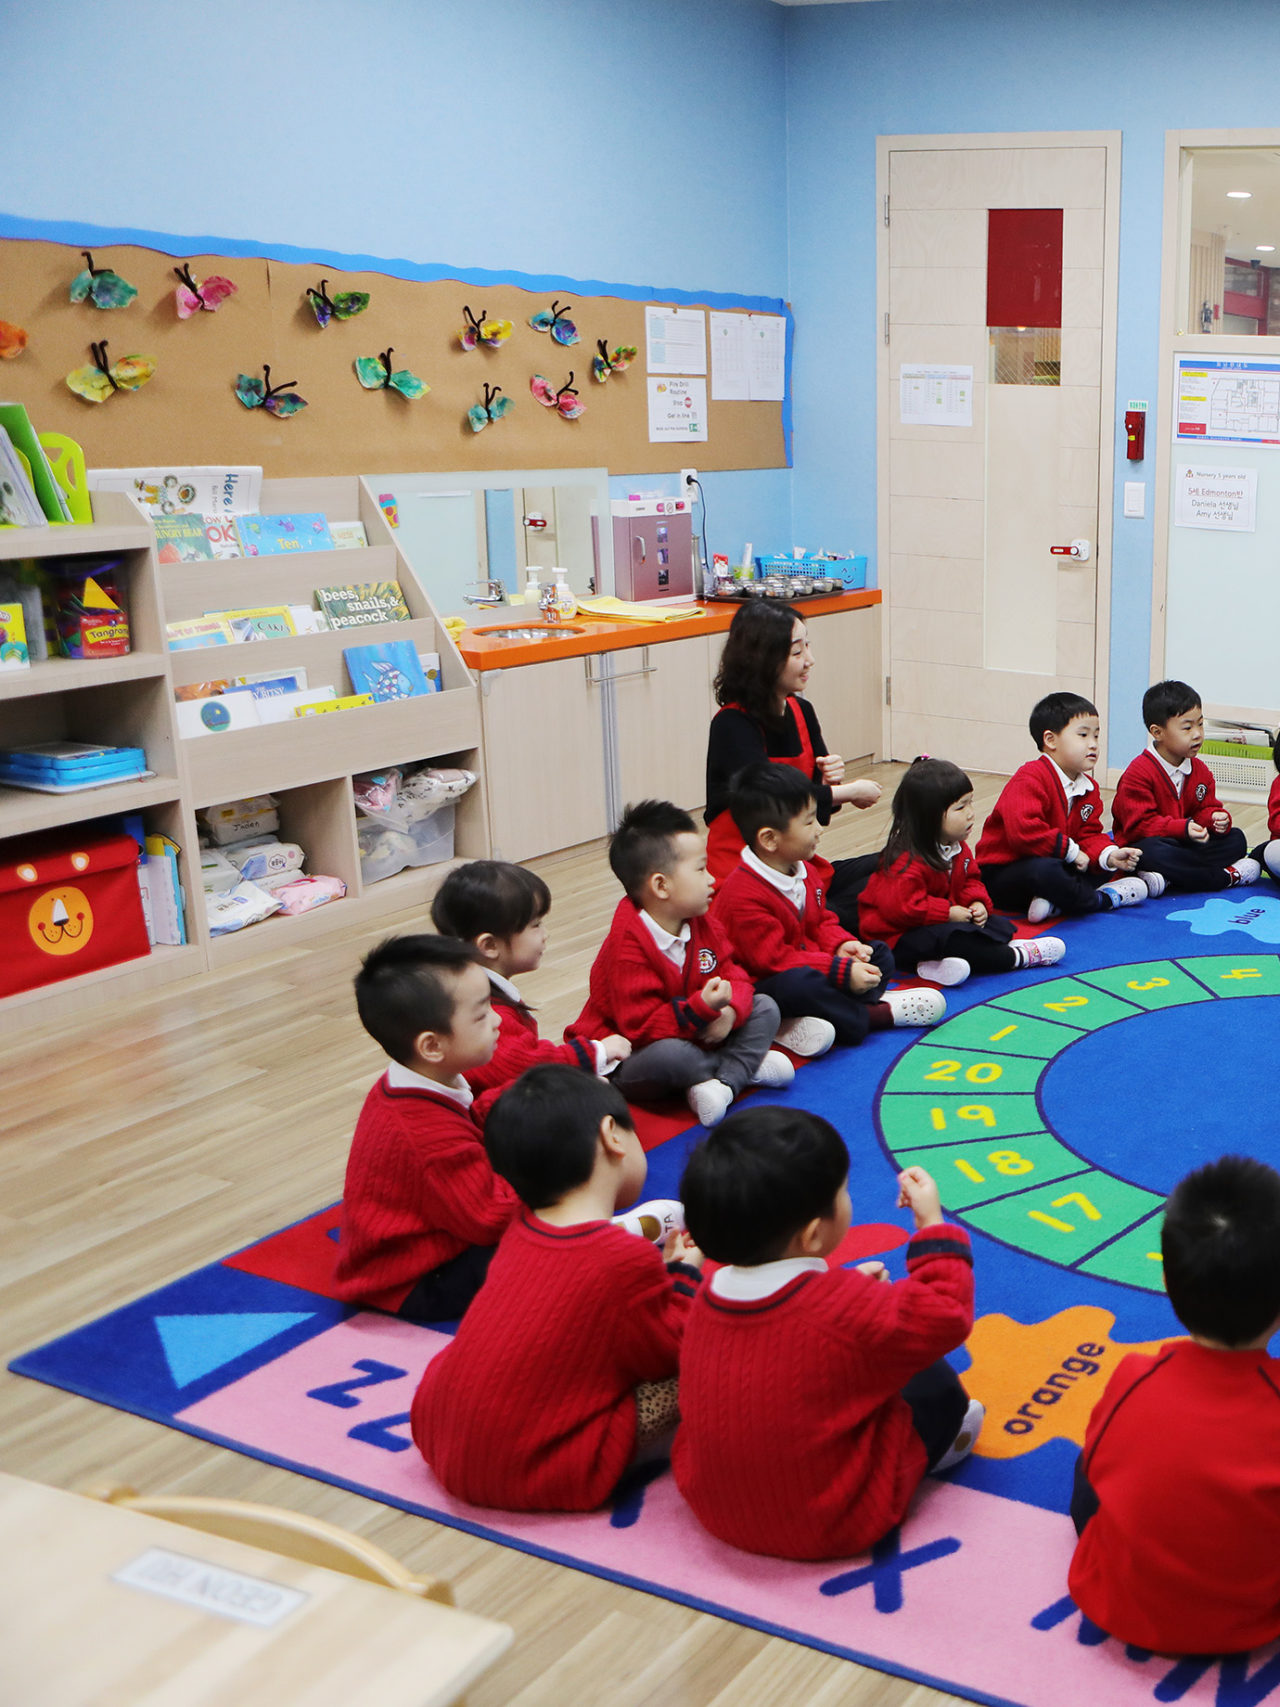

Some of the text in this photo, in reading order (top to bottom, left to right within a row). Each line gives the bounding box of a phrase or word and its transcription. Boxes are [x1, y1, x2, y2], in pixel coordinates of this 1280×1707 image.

[224, 473, 239, 505] Here
[1191, 499, 1217, 508] Daniela
[1196, 509, 1211, 519] Amy
[320, 589, 360, 602] bees,
[330, 609, 389, 631] peacock
[1227, 908, 1266, 925] blue
[1220, 967, 1263, 980] 4
[1126, 976, 1170, 991] 3
[1043, 995, 1089, 1013] 2
[989, 1024, 1018, 1042] 1
[923, 1060, 1003, 1084] 20
[930, 1104, 997, 1130] 19
[954, 1150, 1035, 1183] 18
[1028, 1192, 1102, 1232] 17
[1003, 1340, 1106, 1438] orange
